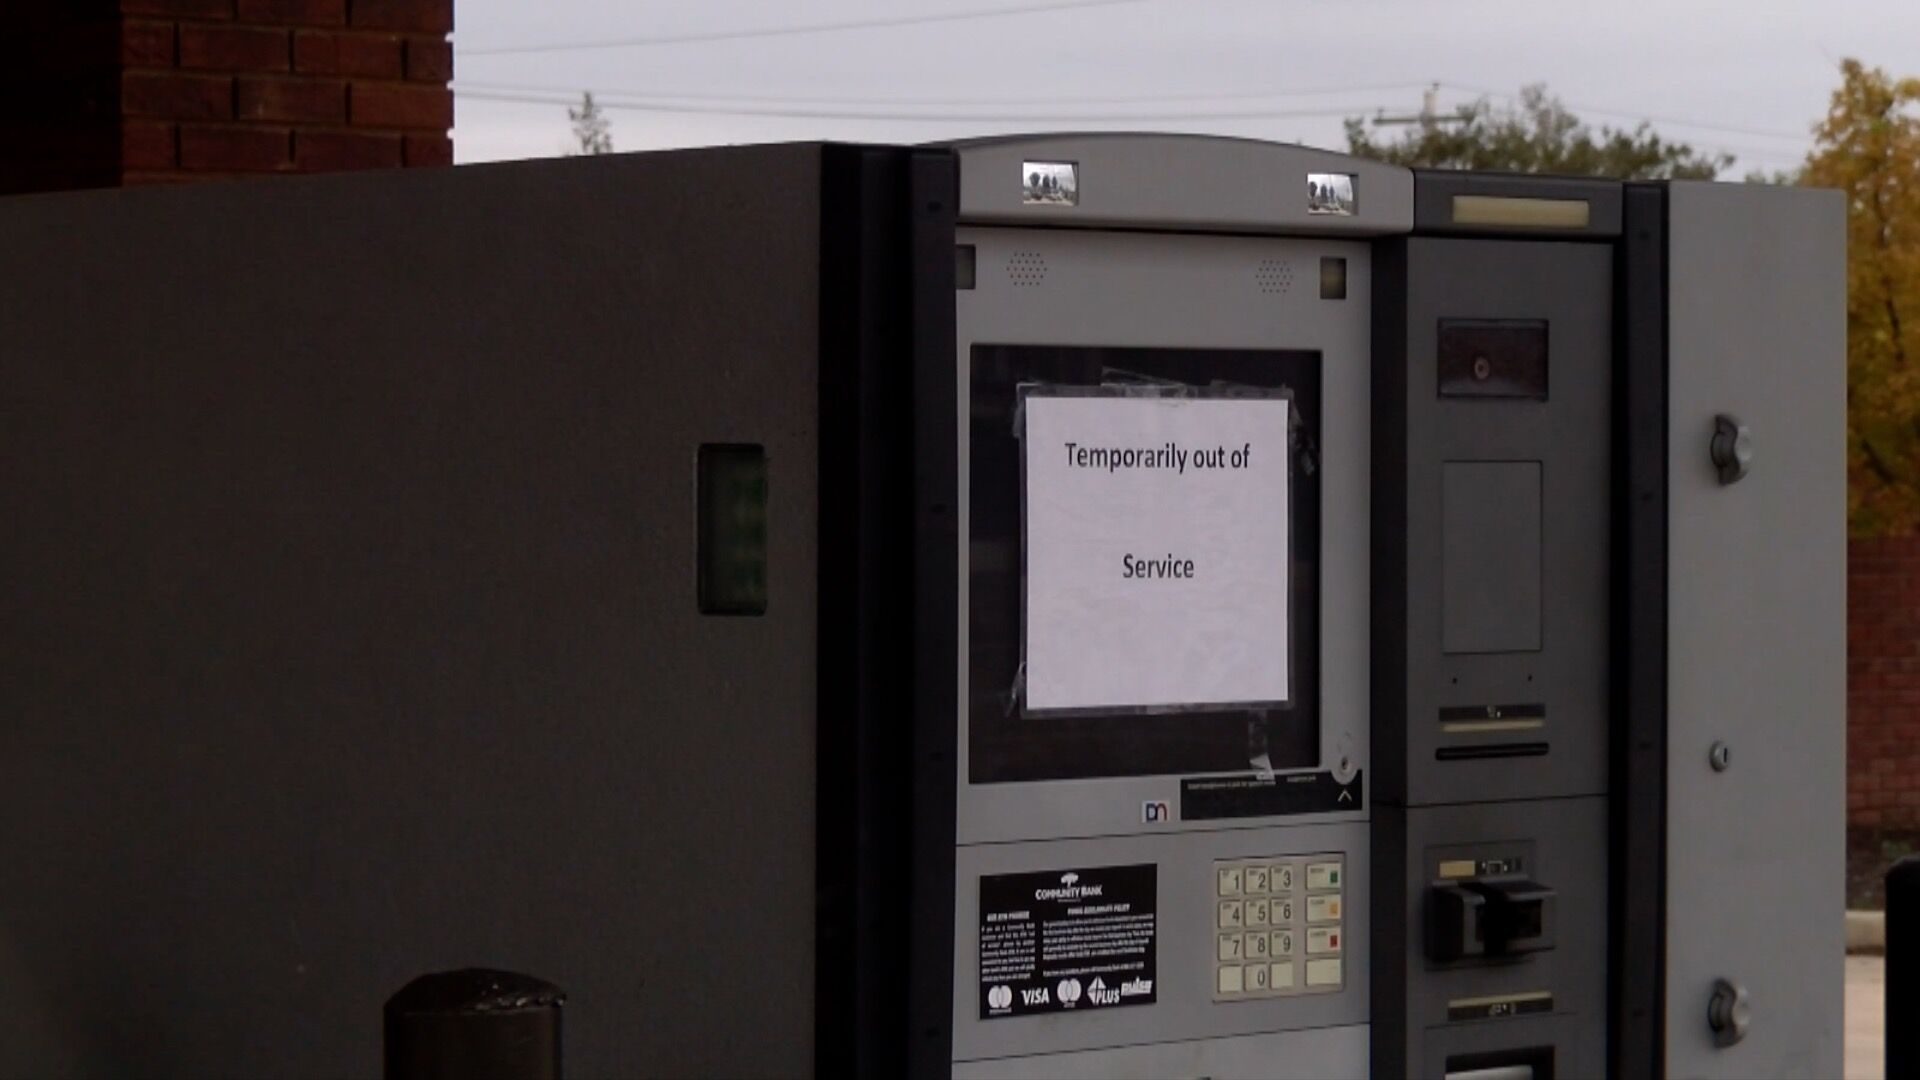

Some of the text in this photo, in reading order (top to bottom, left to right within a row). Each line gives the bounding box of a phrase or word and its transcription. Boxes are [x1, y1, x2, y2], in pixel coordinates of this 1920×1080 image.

[1065, 442, 1250, 474] Temporarily out of
[1122, 553, 1195, 579] Service
[1234, 874, 1240, 890] 1
[1258, 873, 1266, 889] 2
[1283, 870, 1291, 888] 3
[1081, 885, 1102, 897] BANK
[1232, 903, 1291, 923] 4 5 6
[1232, 939, 1240, 955] 7
[1257, 937, 1266, 953] 8
[1283, 935, 1291, 952] 9
[1257, 969, 1265, 986] 0
[1021, 987, 1050, 1006] VISA
